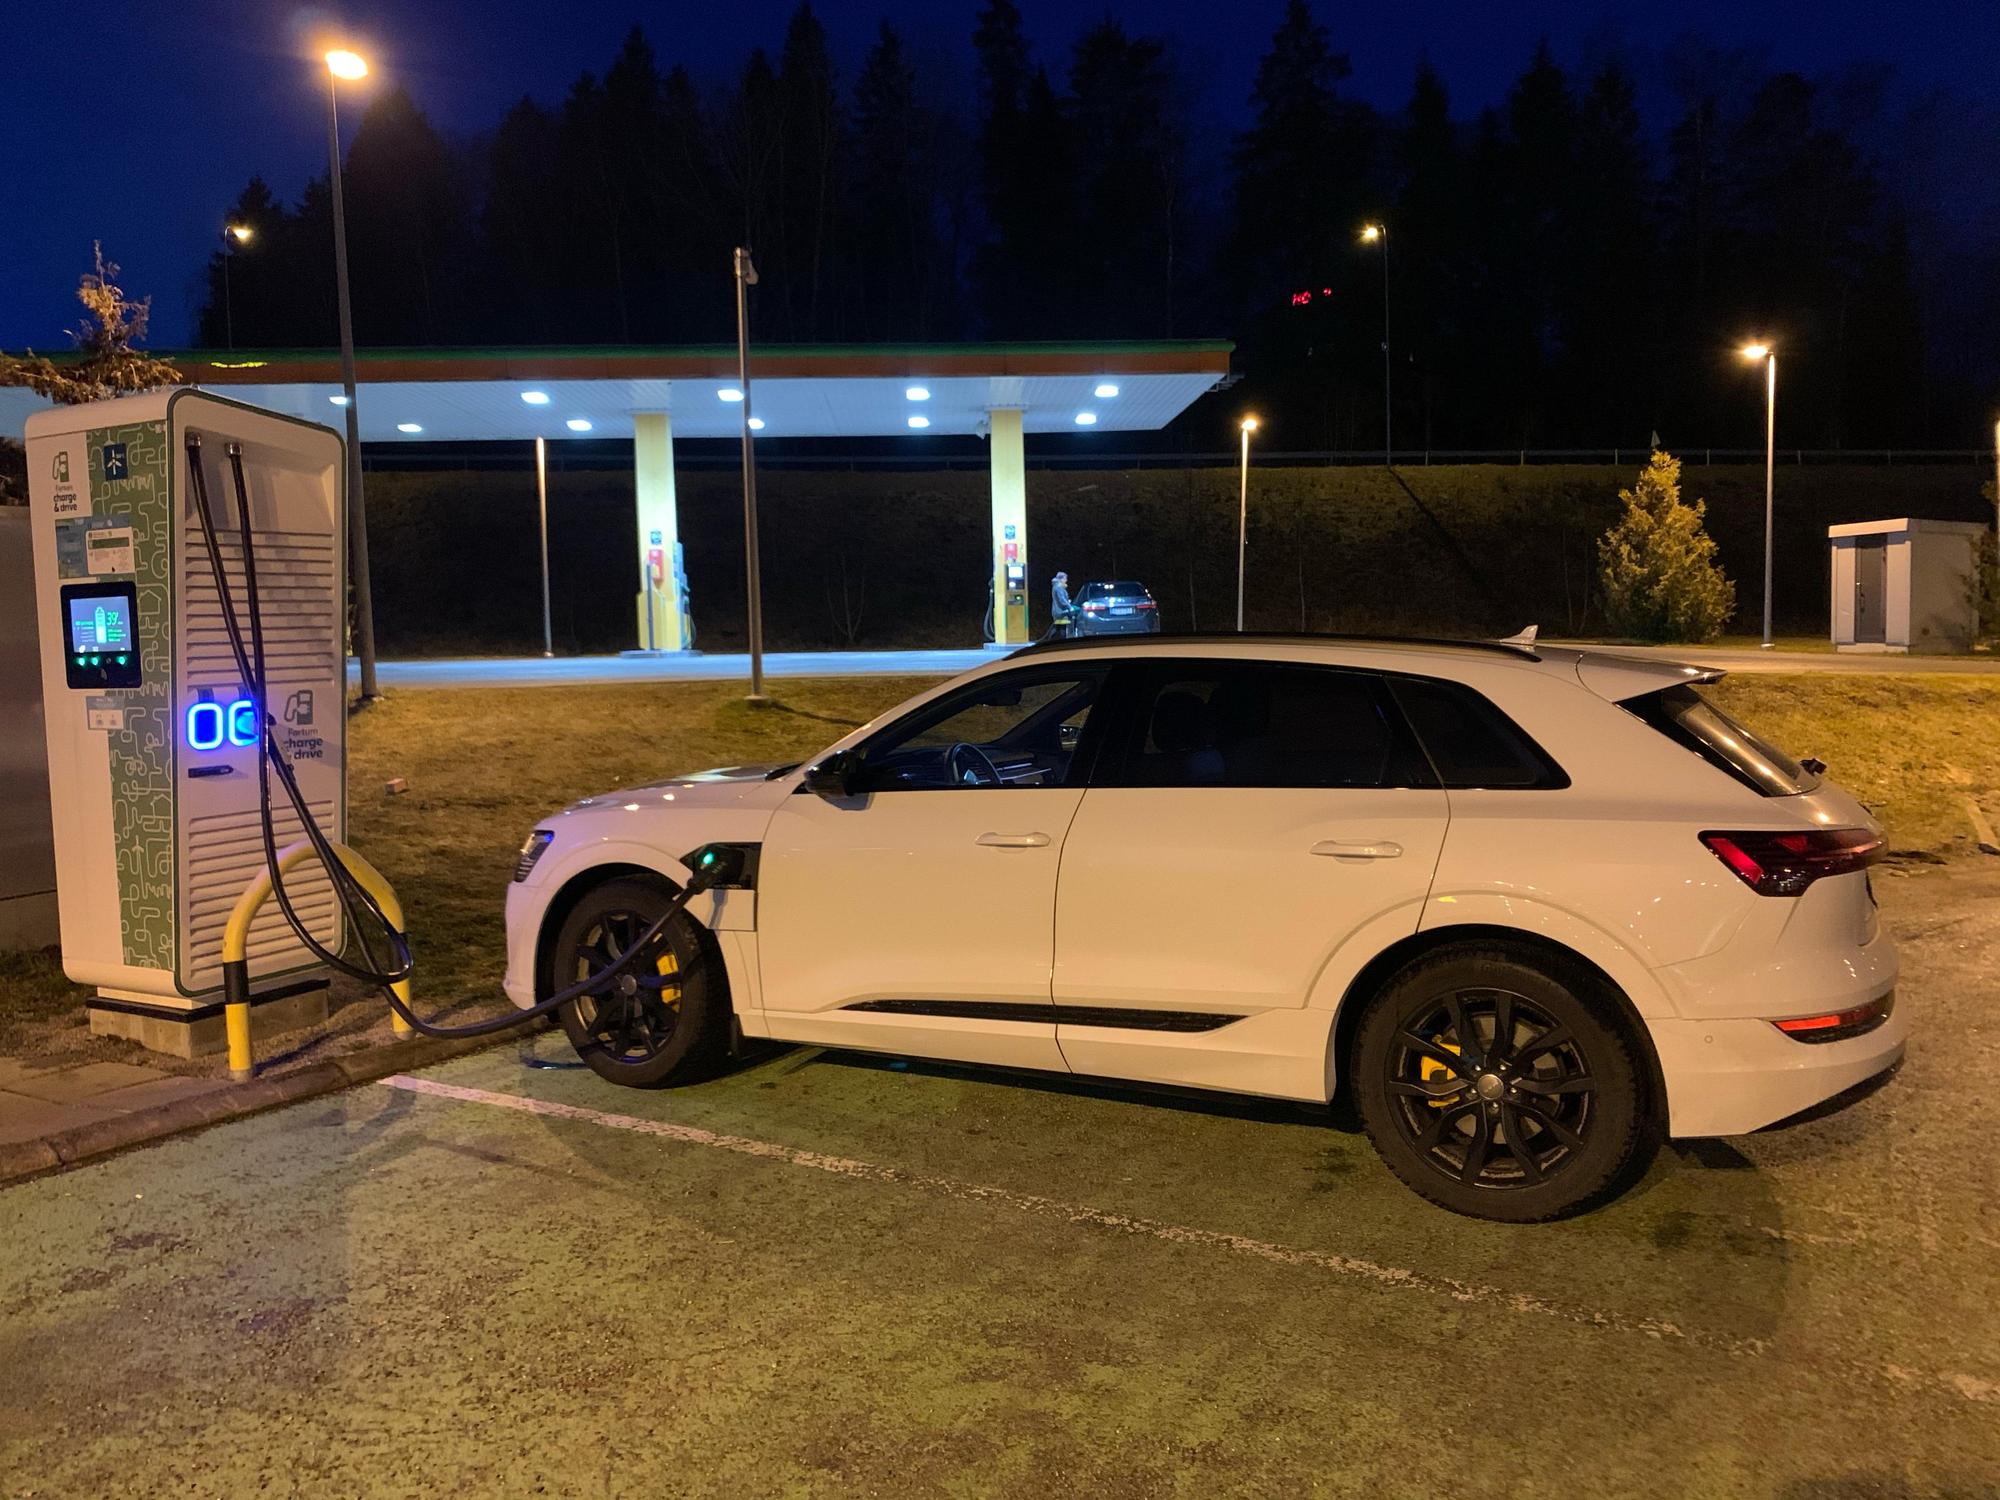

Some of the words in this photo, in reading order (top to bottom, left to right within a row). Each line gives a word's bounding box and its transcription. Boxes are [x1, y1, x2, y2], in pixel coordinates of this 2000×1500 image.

[53, 493, 77, 504] charge
[60, 502, 78, 512] drive
[293, 749, 323, 760] drive
